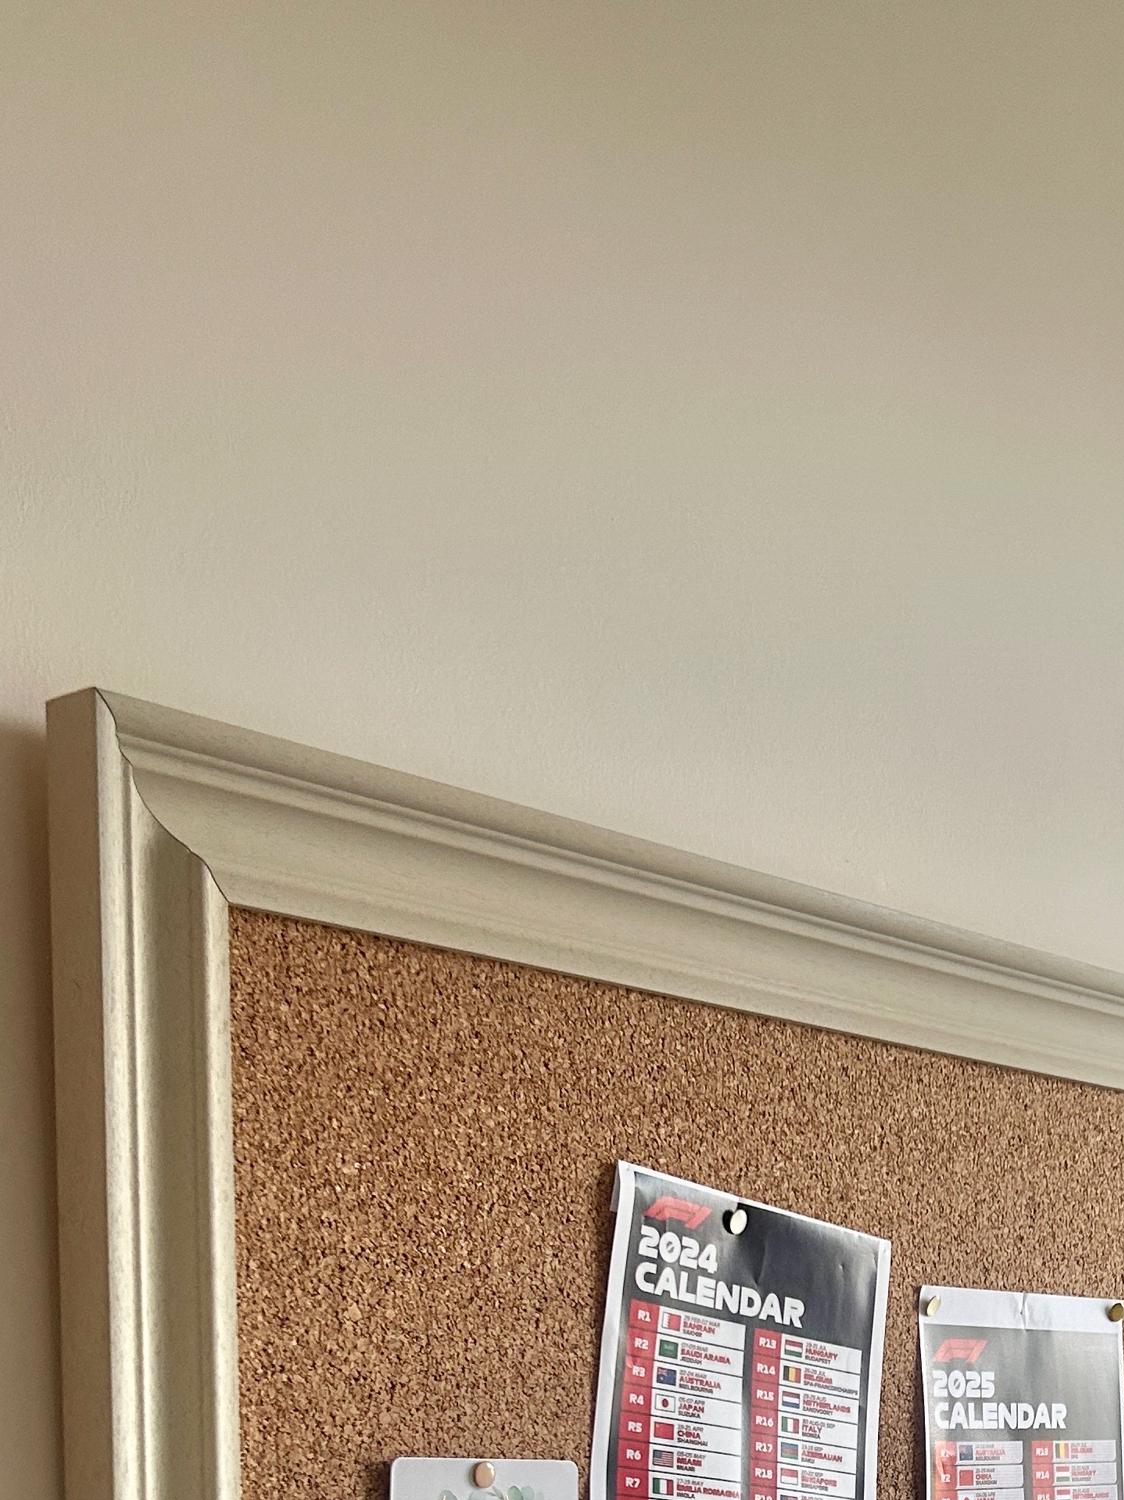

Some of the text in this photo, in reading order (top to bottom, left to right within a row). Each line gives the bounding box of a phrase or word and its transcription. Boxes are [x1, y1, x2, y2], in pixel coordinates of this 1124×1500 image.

[638, 1225, 718, 1274] 2024
[635, 1262, 806, 1329] CALENDAR
[638, 1310, 651, 1322] R1
[634, 1338, 648, 1349] R2
[759, 1337, 776, 1349] R13
[806, 1348, 838, 1360] HUNGARY
[632, 1365, 645, 1377] R3
[757, 1363, 775, 1375] R14
[680, 1376, 721, 1389] AUSTRALIA
[933, 1370, 995, 1399] 2025
[630, 1394, 644, 1405] R4
[757, 1390, 774, 1401] R15
[678, 1403, 704, 1413] JAPAN
[934, 1401, 1068, 1430] CALENDAR
[628, 1422, 642, 1432] R5
[756, 1416, 774, 1427] R16
[802, 1423, 822, 1433] ITALY
[678, 1430, 700, 1439] CHINA
[756, 1442, 773, 1452] R17
[626, 1449, 641, 1460] R6
[755, 1468, 773, 1479] R18
[626, 1477, 640, 1488] R7
